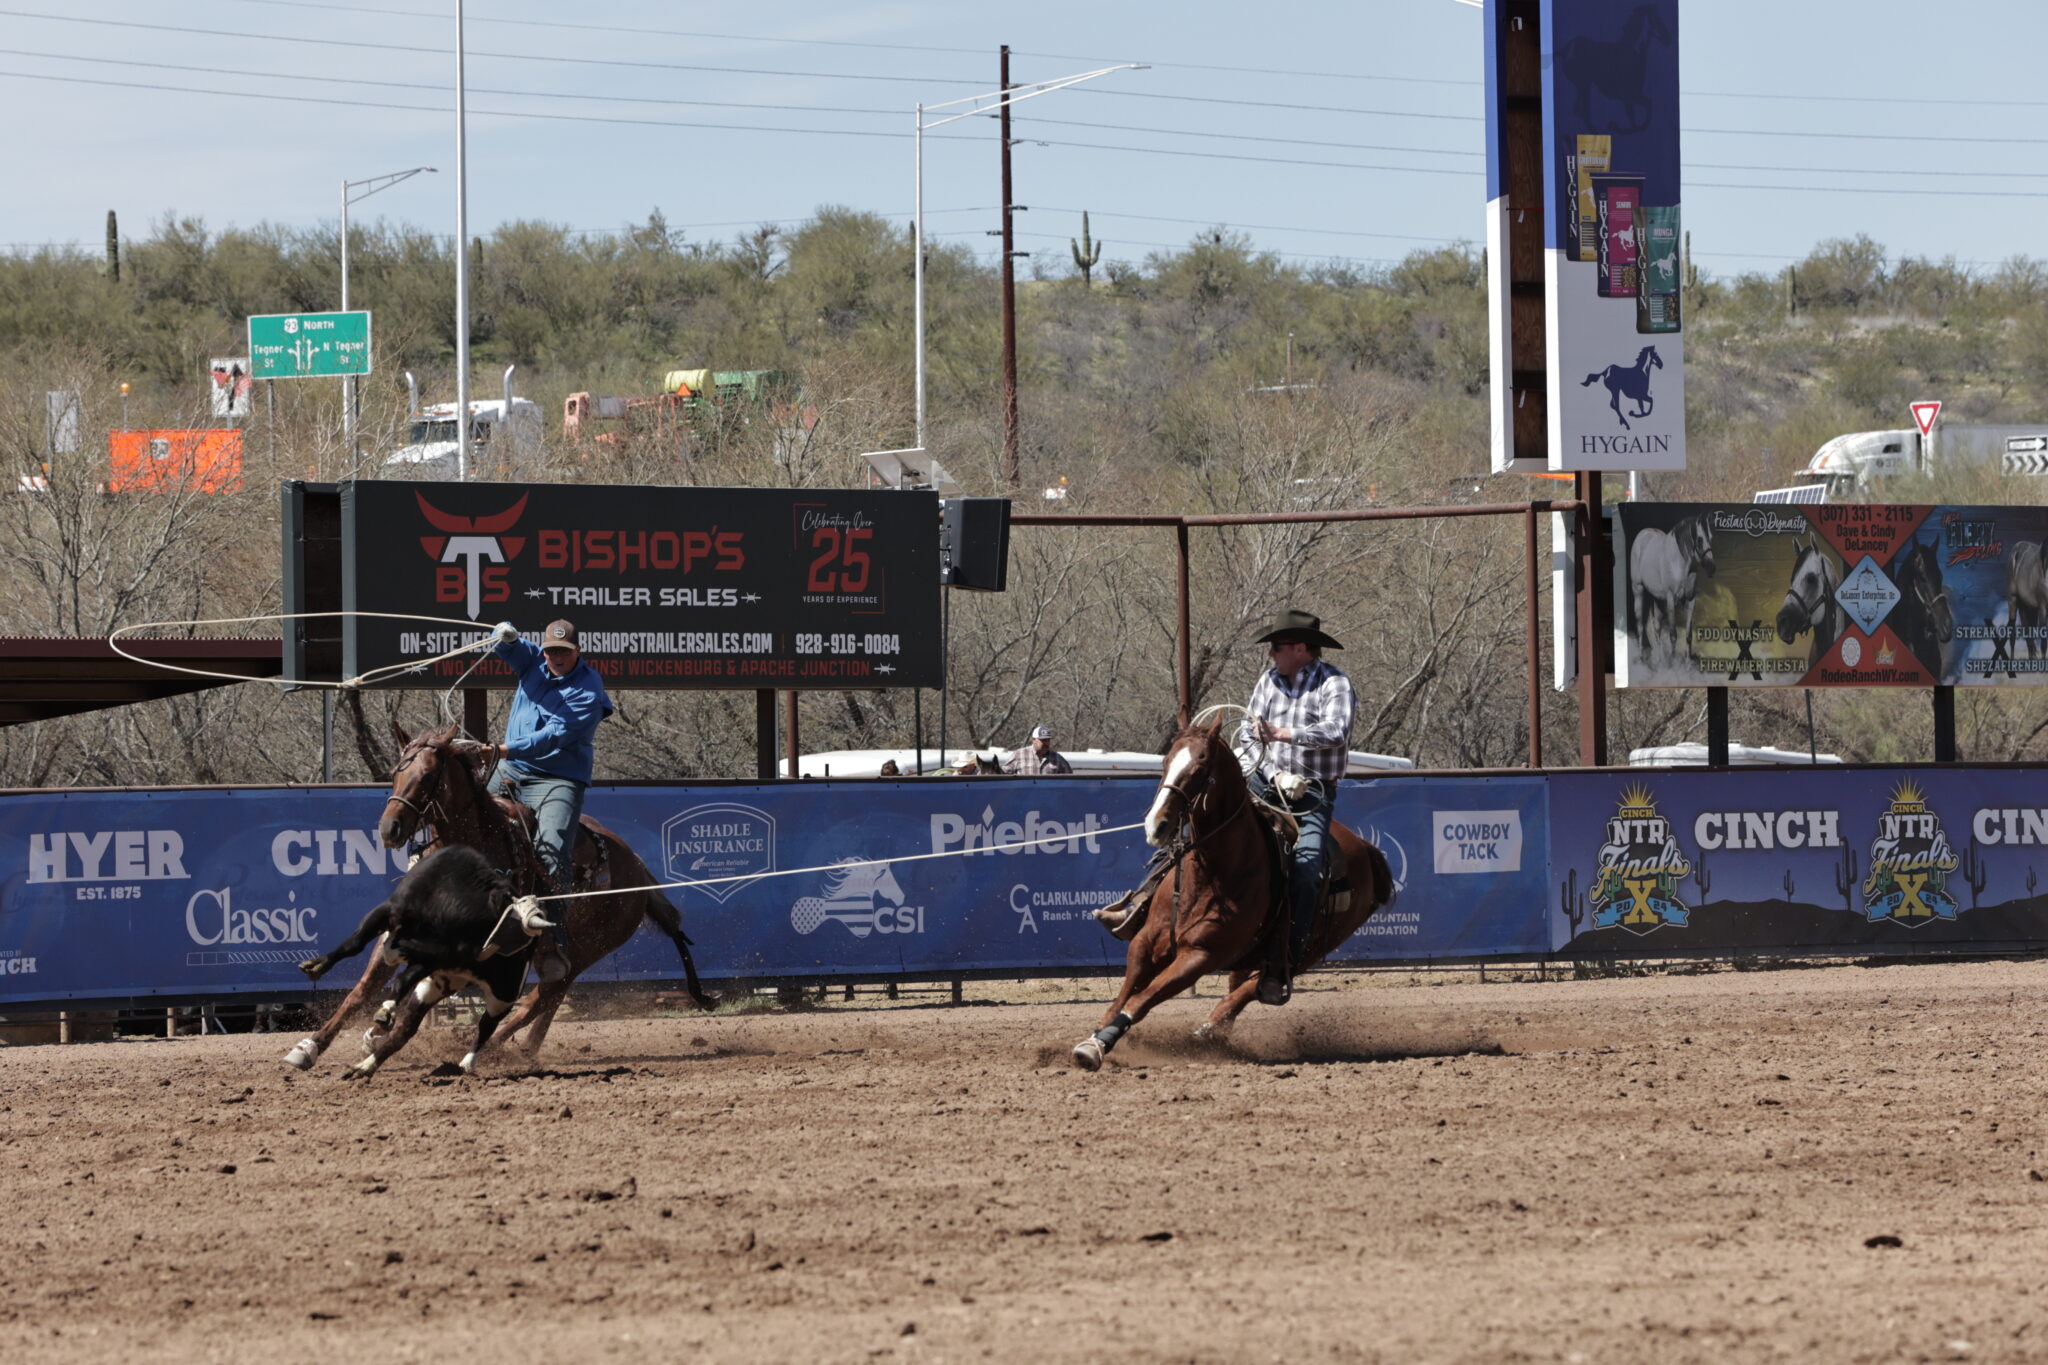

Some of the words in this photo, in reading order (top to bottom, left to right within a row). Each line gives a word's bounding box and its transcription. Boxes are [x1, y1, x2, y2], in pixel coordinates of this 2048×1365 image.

[1566, 155, 1578, 238] HYGAIN
[1599, 200, 1609, 277] HYGAIN
[1637, 227, 1647, 310] HYGAIN
[303, 320, 335, 330] NORTH
[253, 344, 284, 356] Tegner
[323, 342, 330, 351] N
[264, 358, 274, 368] St
[1581, 434, 1670, 454] HYGAIN
[802, 510, 850, 534] Celebrating
[853, 510, 876, 531] Over
[1714, 510, 1743, 528] Fiestas
[1766, 511, 1807, 534] Dynasty
[1819, 505, 1848, 524] (307)
[1852, 505, 1872, 521] 331
[1885, 506, 1913, 521] 2115
[1836, 524, 1859, 537] Dave
[1871, 525, 1896, 540] Cindy
[538, 525, 745, 575] BISHOP'S
[1845, 538, 1889, 553] DeLancey
[807, 527, 874, 592] 25
[547, 587, 651, 606] TRAILER
[659, 588, 738, 606] SALES
[803, 595, 824, 604] YEARS
[826, 595, 835, 603] OF
[837, 595, 878, 604] EXPERIENCE
[1697, 627, 1720, 640] FDD
[1723, 627, 1774, 641] DYNASTY
[1956, 626, 1997, 638] STREAK
[1999, 626, 2014, 638] OF
[2015, 626, 2048, 638] FLING
[400, 632, 458, 653] ON-SITE
[578, 631, 772, 654] BISHOPSTRAILERSALES.COM
[795, 633, 900, 655] 928-916-0084
[434, 660, 464, 676] TWO
[628, 659, 722, 676] WICKENBURG
[726, 660, 736, 676] &
[740, 660, 796, 676] APACHE
[800, 660, 870, 676] JUNCTION
[1700, 659, 1763, 672] FIREWATER
[1621, 809, 1653, 818] CINCH
[1892, 804, 1923, 813] CINCH
[690, 823, 752, 838] SHADLE
[930, 804, 1101, 857] Priefert
[1443, 823, 1510, 841] COWBOY
[1612, 819, 1665, 845] NTR
[1694, 811, 1840, 849] CINCH
[1884, 814, 1934, 840] NTR
[675, 839, 764, 855] INSURANCE
[1458, 842, 1499, 860] TACK
[26, 830, 191, 884] HYER
[1864, 832, 1957, 894] Finals
[1592, 838, 1689, 901] Finals
[76, 887, 107, 900] EST.
[110, 886, 141, 899] 1875
[1624, 879, 1659, 925] X
[1893, 873, 1932, 918] X
[186, 886, 318, 946] Classic
[873, 906, 924, 934] CSI
[1043, 911, 1071, 920] Ranch
[1367, 912, 1420, 923] OUNTAIN
[1353, 925, 1418, 936] OUNDATION
